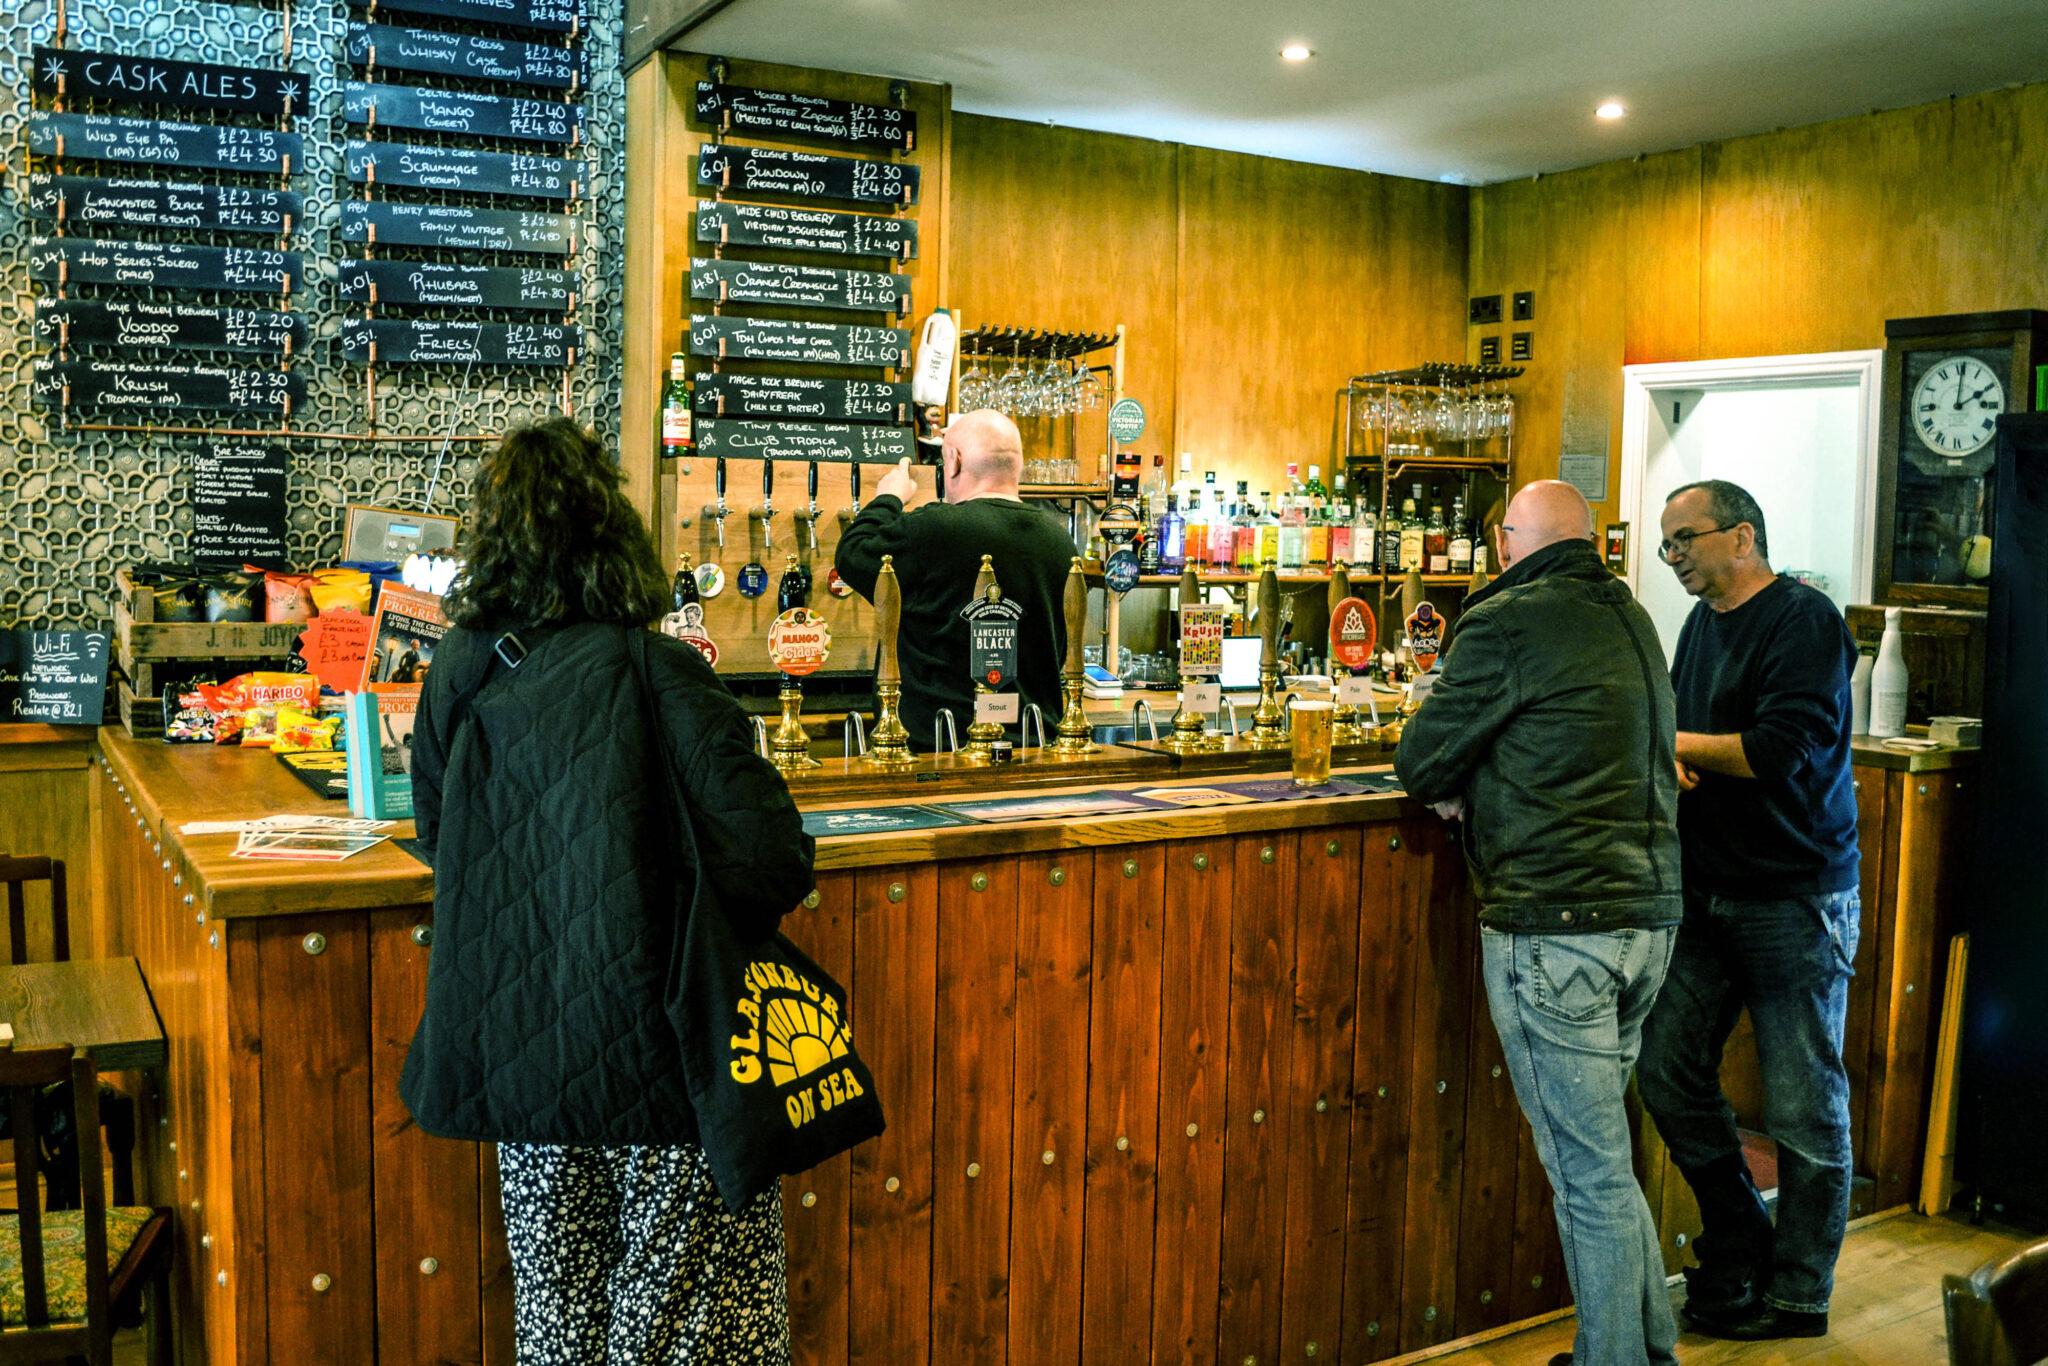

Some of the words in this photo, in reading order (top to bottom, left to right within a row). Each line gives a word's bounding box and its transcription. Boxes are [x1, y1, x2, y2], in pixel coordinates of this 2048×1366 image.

[405, 29, 460, 46] THISTLY
[469, 37, 505, 51] CROSS
[399, 44, 456, 63] WHISKY
[466, 52, 498, 67] CASK
[85, 62, 168, 93] CASK
[181, 71, 257, 99] ALES
[416, 88, 452, 98] CELTIC
[420, 102, 474, 118] MANGO
[731, 98, 760, 113] FRUIT
[85, 115, 111, 125] WILD
[775, 118, 788, 127] ICE
[86, 129, 118, 145] WILD
[451, 148, 477, 158] CIDER
[400, 156, 479, 174] SCRUMMAGE
[744, 159, 810, 179] SUNDOWN
[85, 191, 157, 209] LANCASTER
[169, 196, 204, 210] BLACK
[699, 201, 716, 211] ABV
[347, 203, 368, 213] ABV
[392, 205, 422, 217] HENRY
[428, 207, 474, 218] WESTONS
[764, 208, 789, 221] CHILD
[791, 211, 836, 226] BREWERY
[420, 222, 457, 233] FAMILY
[461, 224, 504, 235] VINTAGE
[96, 239, 130, 249] ATTIC
[135, 240, 164, 251] BREW
[79, 251, 108, 267] HOP
[116, 269, 155, 282] (PALE)
[748, 262, 775, 273] VAULT
[778, 265, 798, 277] CITY
[408, 272, 478, 292] RHUBARB
[736, 273, 780, 288] ORANGE
[106, 303, 130, 313] WYE
[138, 304, 173, 317] VALLEY
[177, 308, 219, 319] BREWERY
[118, 317, 179, 333] VOODOO
[117, 333, 171, 345] (COPPER)
[418, 334, 473, 350] FRIELS
[758, 331, 784, 345] CHAOS
[787, 334, 807, 345] MORE
[115, 375, 168, 392] KRUSH
[696, 373, 712, 382] ABV
[729, 374, 757, 386] MAGIC
[761, 377, 781, 387] ROCK
[784, 377, 825, 390] BREWING
[97, 391, 153, 405] (TROPICAL
[158, 393, 181, 406] IPA)
[770, 404, 783, 412] ICE
[787, 402, 826, 416] PORTER)
[698, 420, 715, 429] ABV
[738, 421, 772, 432] TINY
[777, 422, 817, 432] REBEL
[729, 434, 780, 446] CLWB
[785, 435, 838, 446] TROPICA
[213, 445, 231, 456] BAR
[201, 535, 223, 545] PORK
[383, 599, 439, 622] PROGRES
[973, 628, 1016, 637] LANCASTER
[1184, 626, 1222, 638] KRUSH
[782, 634, 820, 644] MANGO
[976, 637, 1012, 649] BLACK
[252, 687, 304, 699] HARIBO
[1196, 693, 1207, 701] IPA
[988, 703, 1007, 712] Stout
[786, 1087, 815, 1129] ON
[818, 1067, 864, 1112] SEA
